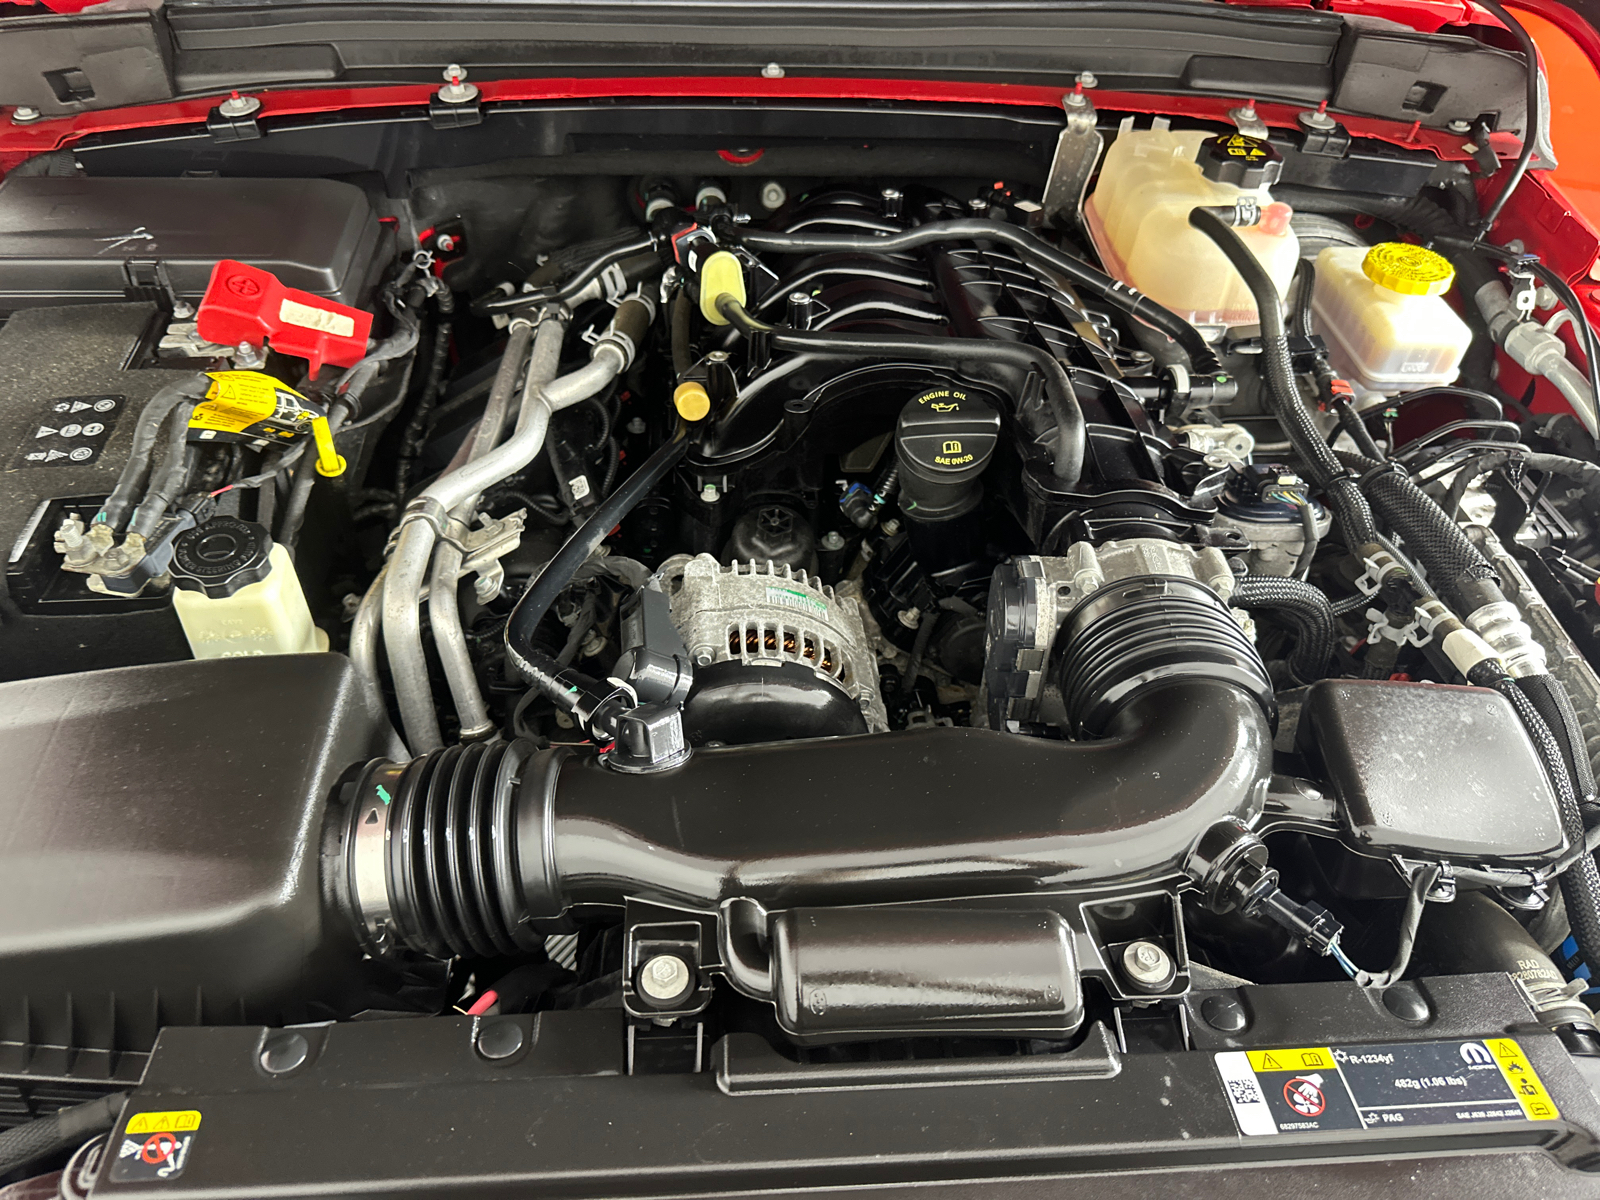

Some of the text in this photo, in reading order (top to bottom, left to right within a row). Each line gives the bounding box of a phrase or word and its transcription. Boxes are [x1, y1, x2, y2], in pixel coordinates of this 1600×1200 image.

[918, 390, 967, 404] ENGINE OIL
[934, 454, 974, 465] SAE 0W-20
[1516, 959, 1540, 970] RAD
[1349, 1053, 1394, 1065] R-1234yf
[1394, 1075, 1468, 1089] 482g (1.06 lbs)
[1381, 1113, 1405, 1123] PAG
